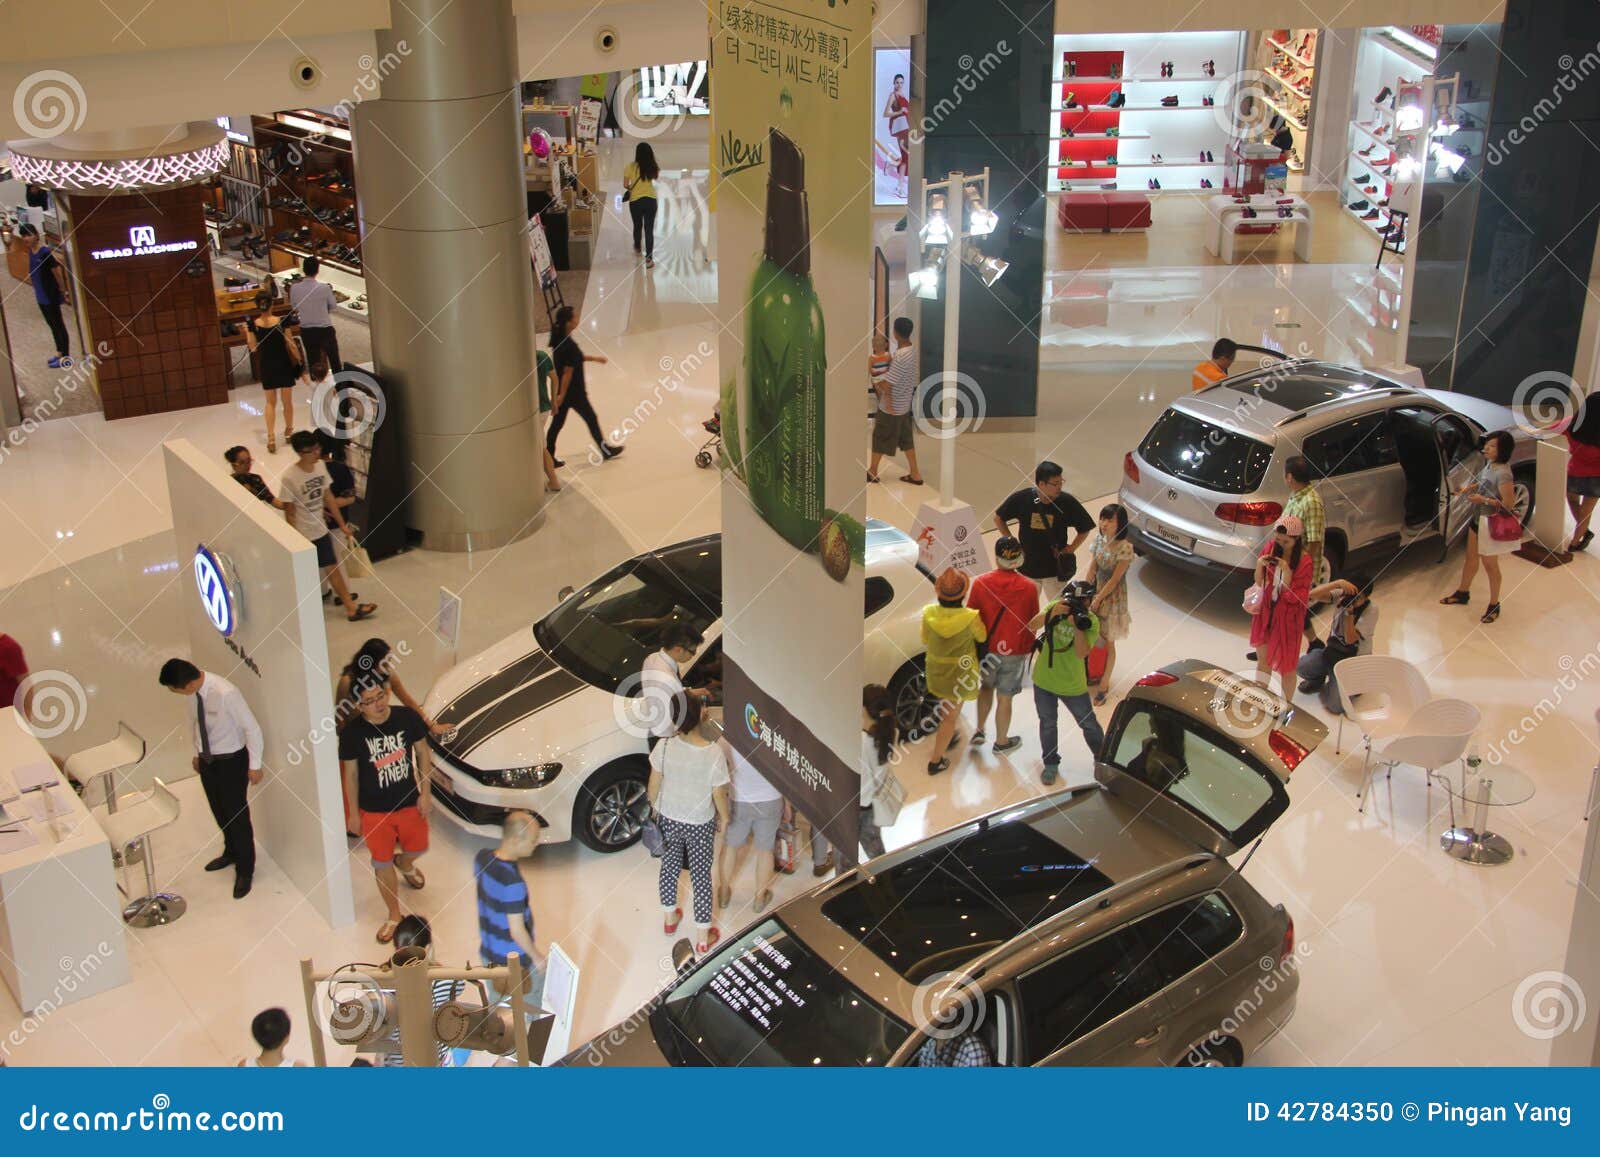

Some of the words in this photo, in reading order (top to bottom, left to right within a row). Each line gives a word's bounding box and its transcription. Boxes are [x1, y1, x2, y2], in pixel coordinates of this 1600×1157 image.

[726, 37, 740, 64] 더
[746, 42, 781, 78] 그린티
[785, 54, 813, 83] 씨드
[817, 65, 839, 100] 세럼
[721, 130, 763, 167] New
[1157, 524, 1180, 542] Tiguan
[759, 719, 800, 774] 海岸城
[800, 755, 832, 793] COASTAL
[800, 768, 818, 792] CITY
